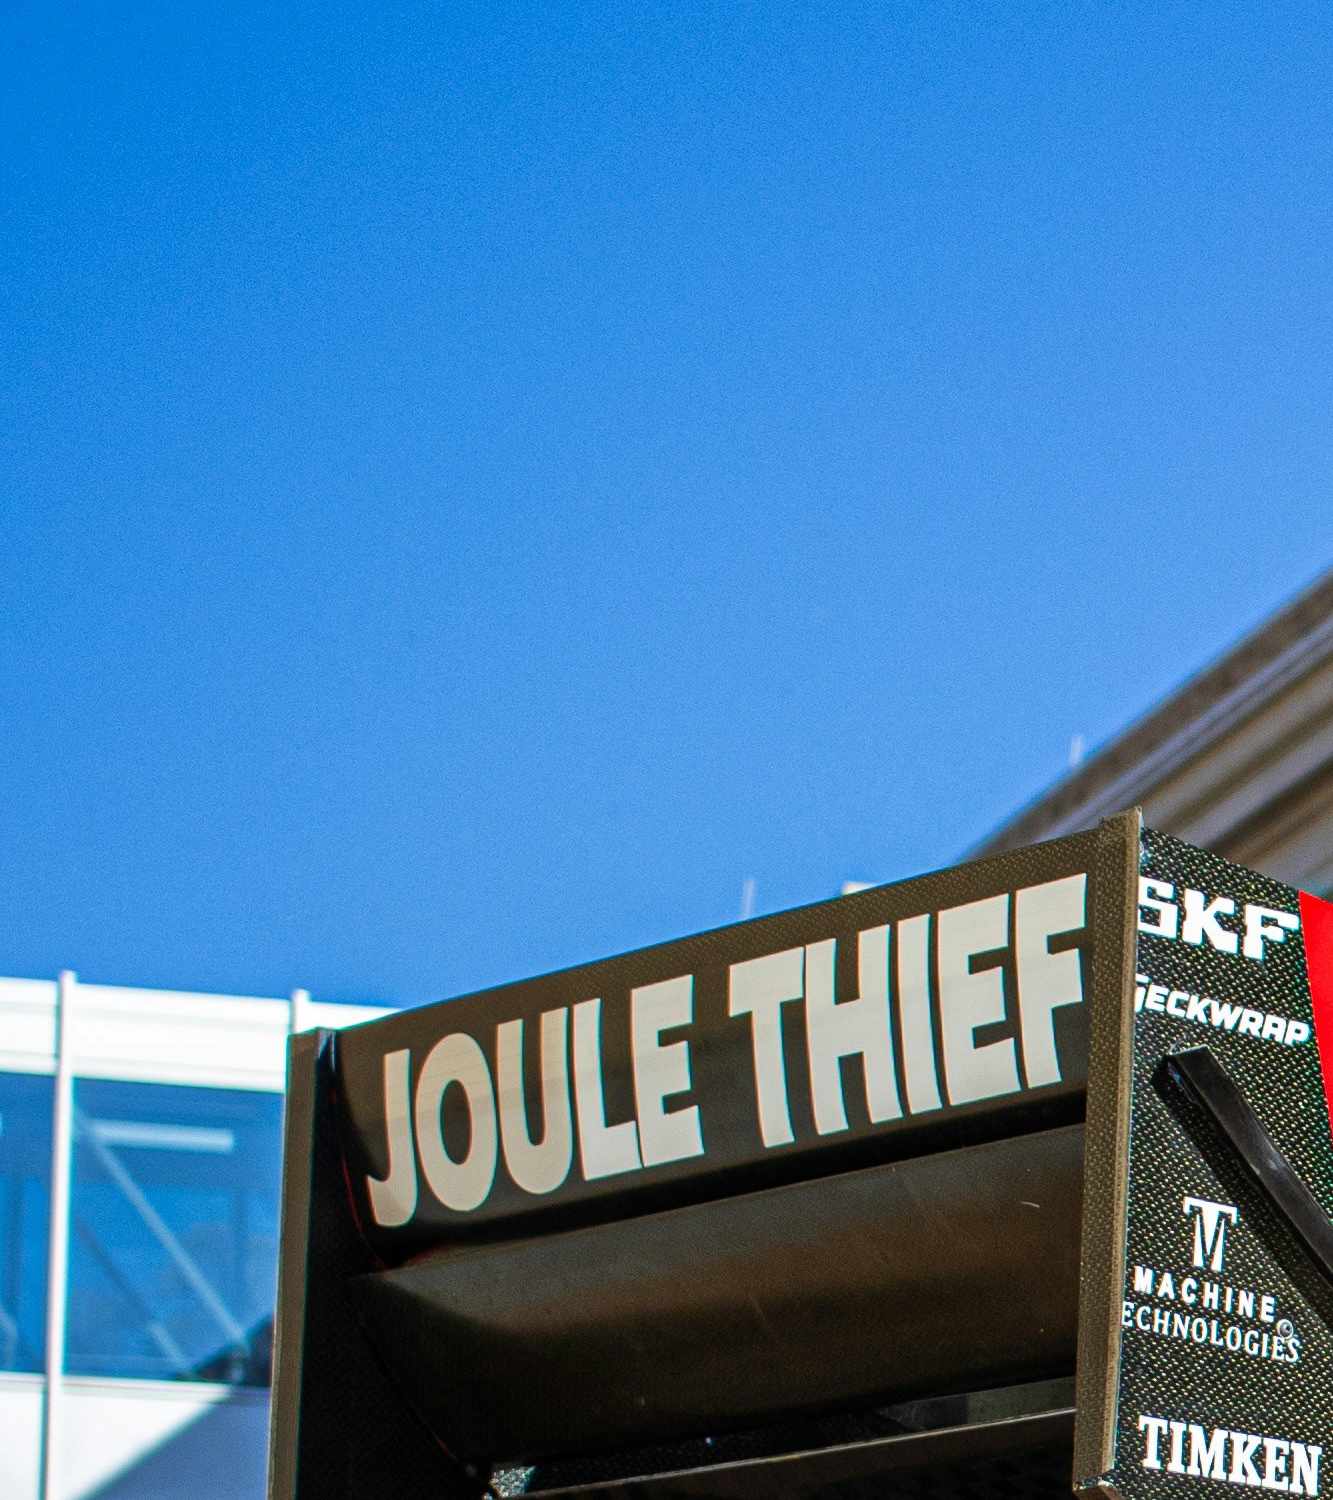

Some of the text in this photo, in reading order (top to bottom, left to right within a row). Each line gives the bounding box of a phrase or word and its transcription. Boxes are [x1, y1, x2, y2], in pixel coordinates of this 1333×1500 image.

[1137, 875, 1300, 960] SKF
[367, 873, 1087, 1227] JOULE THIEF
[1134, 1266, 1276, 1323] MACHINE
[1138, 1414, 1323, 1496] TIMKEN
